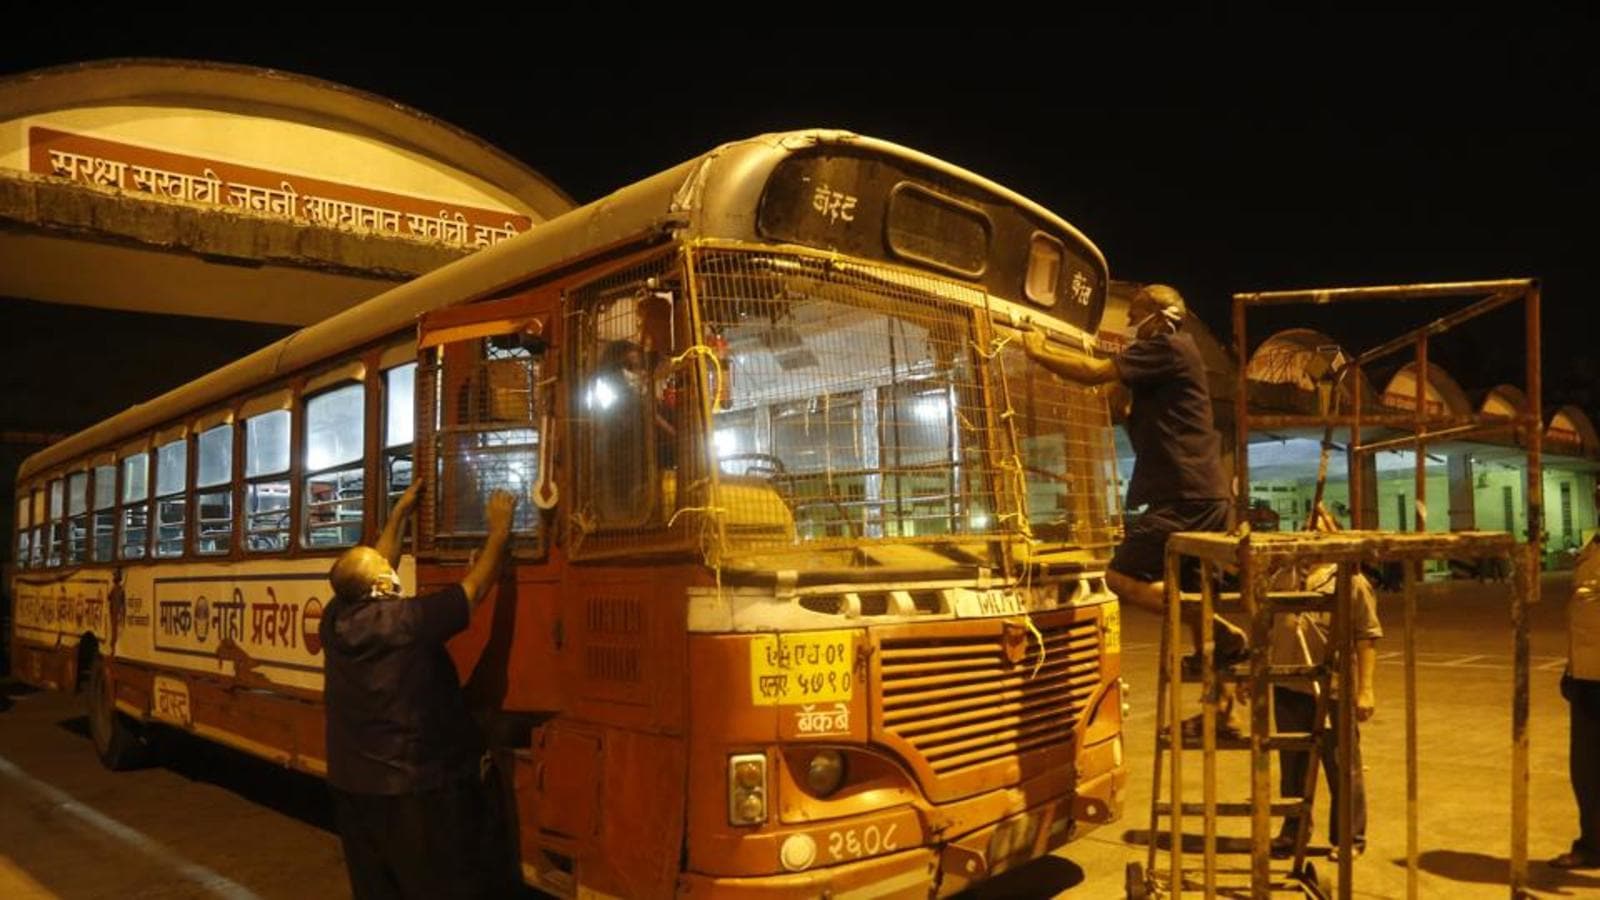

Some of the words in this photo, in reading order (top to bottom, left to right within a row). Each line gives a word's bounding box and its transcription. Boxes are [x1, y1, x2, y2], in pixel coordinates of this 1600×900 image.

[226, 180, 299, 217] जननी
[159, 600, 193, 637] मास्क
[211, 587, 246, 642] नाही
[251, 586, 299, 649] प्रवेश
